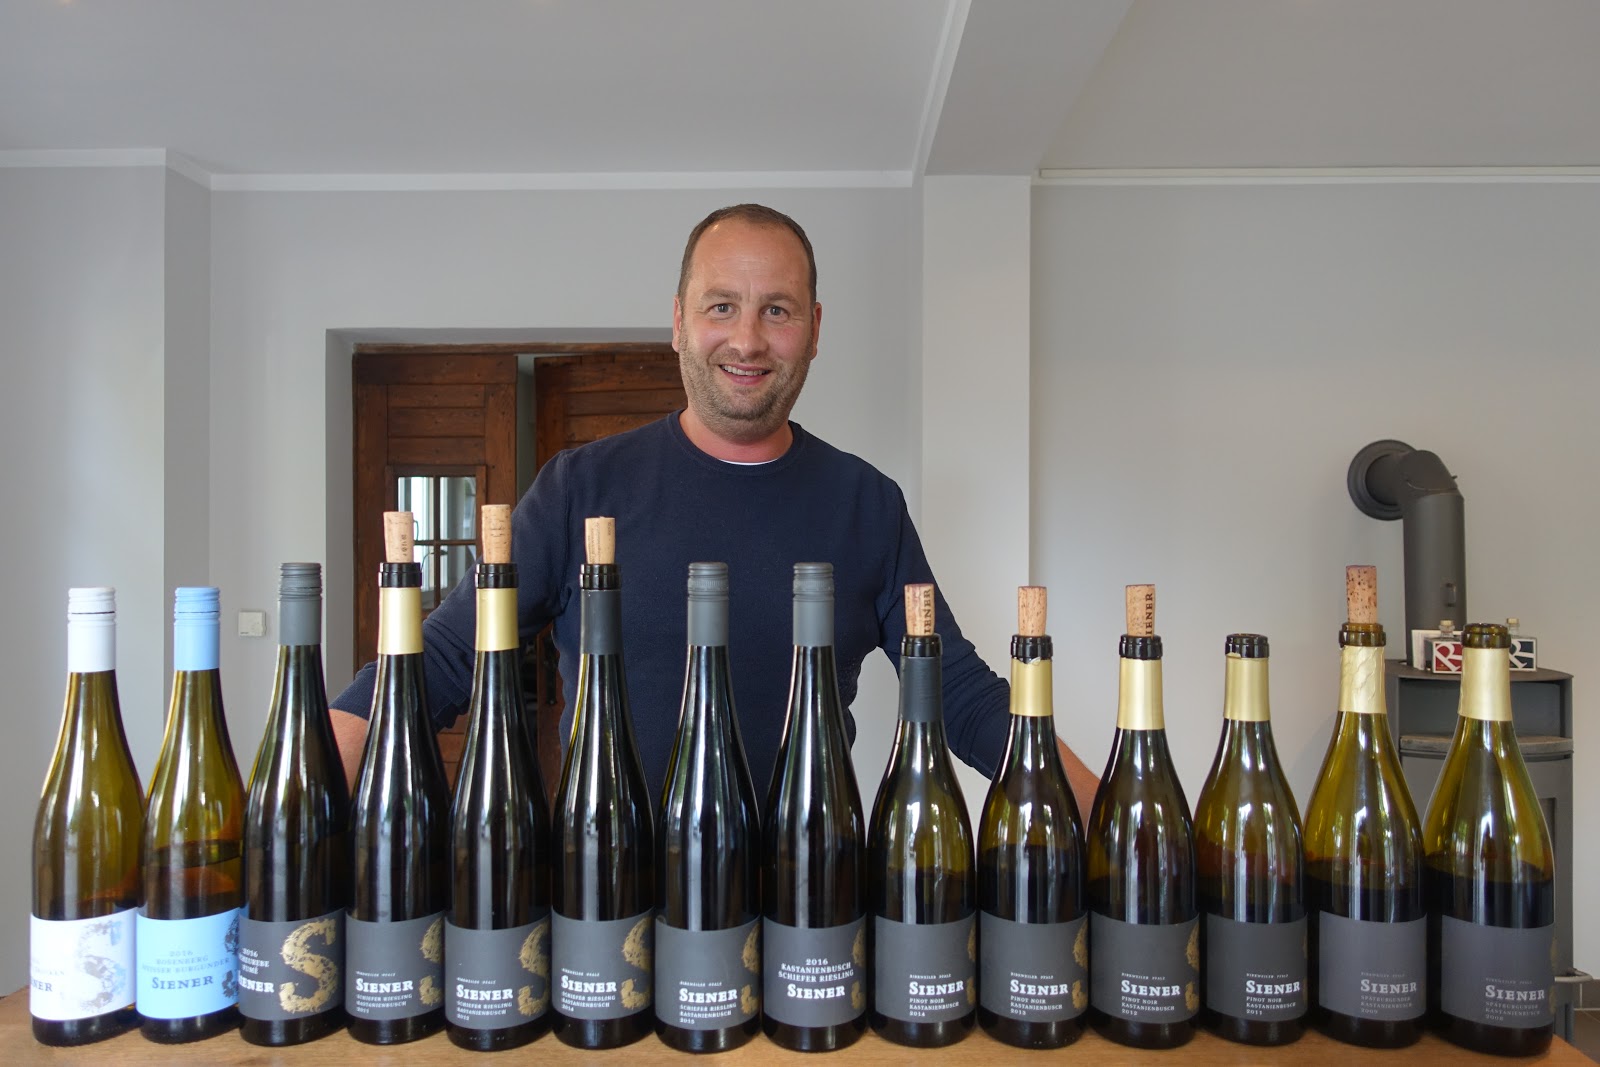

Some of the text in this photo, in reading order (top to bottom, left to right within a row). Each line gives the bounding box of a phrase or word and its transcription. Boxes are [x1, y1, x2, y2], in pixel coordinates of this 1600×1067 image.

[924, 589, 932, 634] IENER
[1145, 593, 1153, 635] IENER
[781, 962, 851, 974] KASTANIENBUSCH
[806, 958, 829, 966] 2016
[152, 975, 213, 990] SIENER
[778, 969, 854, 983] SCHIEFER RIESLING
[356, 978, 413, 993] SIENER
[561, 975, 617, 993] SIENER
[787, 983, 846, 999] SIENER
[909, 980, 964, 996] SIENER
[1010, 979, 1069, 996] SIENER
[1121, 979, 1181, 997] SIENER
[1245, 979, 1301, 995] SIENER
[1360, 978, 1417, 994] SIENER
[456, 984, 513, 1001] SIENER
[679, 988, 738, 1004] SIENER
[1010, 995, 1029, 1003] PINOT
[1485, 984, 1545, 1001] SIENER
[709, 1002, 737, 1012] RIESLING
[909, 1001, 960, 1011] KASTANIENBUSCH
[1010, 1001, 1063, 1011] KASTANIENBUSCH
[1121, 1002, 1175, 1011] KASTANIENBUSCH
[1121, 1008, 1138, 1016] 2012
[1246, 1001, 1296, 1010] KASTANIENBUSCH
